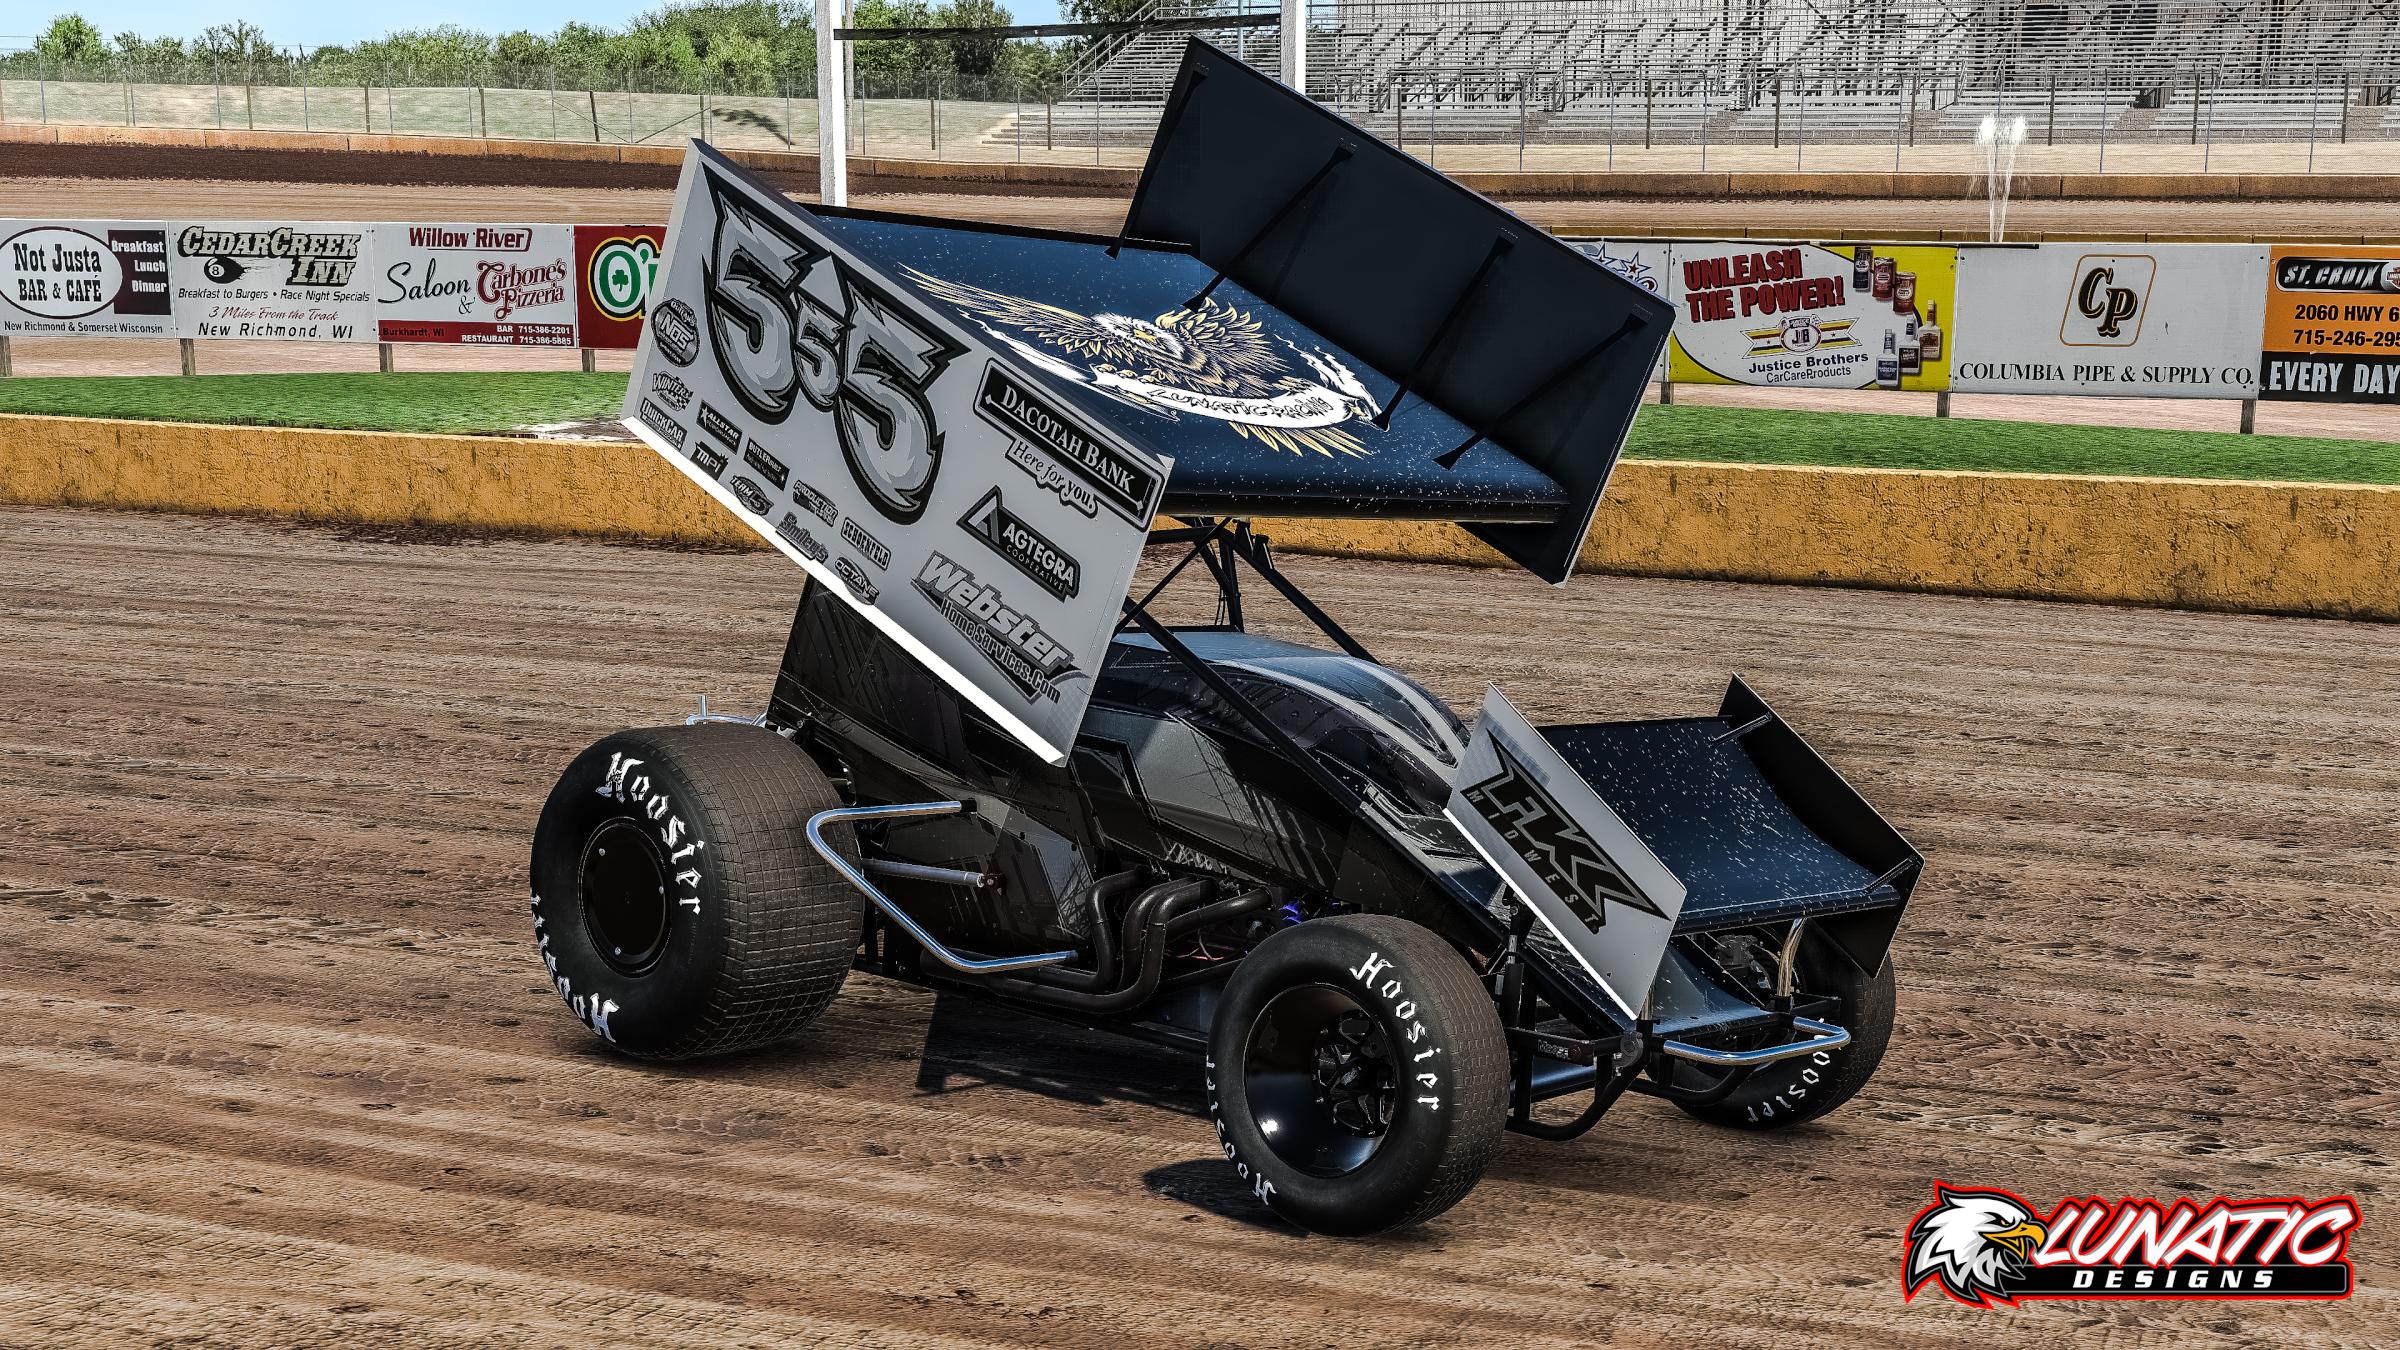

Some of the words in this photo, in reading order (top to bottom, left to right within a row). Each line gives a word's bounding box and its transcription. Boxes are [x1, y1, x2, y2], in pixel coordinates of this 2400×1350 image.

[111, 240, 165, 253] Breakfast
[409, 227, 469, 248] Willow
[475, 228, 525, 248] River
[13, 243, 47, 271] Not
[52, 244, 102, 272] Justa
[134, 260, 166, 272] Lunch
[1683, 248, 1803, 291] UNLEASH
[18, 279, 47, 301] BAR
[53, 282, 61, 299] &
[66, 275, 102, 302] CAFÉ
[131, 280, 167, 293] Dinner
[377, 258, 471, 304] Saloon
[477, 258, 567, 305] Carbone's
[2284, 264, 2311, 285] ST.
[2315, 264, 2380, 288] CROIX
[178, 288, 220, 299] Breakfast
[223, 289, 233, 299] to
[235, 289, 269, 301] Burgers
[280, 289, 302, 300] Race
[306, 290, 330, 302] Night
[332, 290, 370, 302] Specials
[458, 296, 475, 315] &
[494, 282, 565, 321] Pizzeria
[1685, 288, 1736, 323] THE
[1740, 275, 1846, 317] POWER!
[4, 321, 22, 331] New
[24, 321, 66, 332] Richmond
[68, 322, 75, 332] &
[78, 322, 117, 333] Somerset
[119, 323, 163, 333] Wisconsin
[209, 306, 220, 318] 3
[222, 306, 256, 319] Miles
[308, 309, 339, 321] Track
[2295, 304, 2339, 321] 2060
[2344, 305, 2384, 322] HWY
[198, 323, 231, 336] New
[239, 323, 322, 339] Richmond,
[332, 325, 353, 338] WI
[383, 327, 432, 338] Burkhardt,
[433, 328, 445, 337] WI
[462, 335, 514, 344] RESTAURANT
[519, 336, 572, 346] 715-386-5885
[497, 325, 514, 333] BAR
[518, 326, 570, 335] 715-386-2201
[660, 313, 695, 351] NOS
[1749, 359, 1801, 373] Justice
[1806, 353, 1869, 368] Brothers
[1960, 363, 2065, 381] COLUMBIA
[2073, 364, 2115, 383] PIPE
[2121, 365, 2136, 383] &
[2142, 366, 2217, 385] SUPPLY
[2221, 367, 2254, 385] CO.
[652, 373, 690, 399] WINTERS
[2269, 361, 2344, 392] EVERY
[2353, 364, 2400, 394] DAY
[707, 412, 740, 440] ALLSTAR
[1001, 384, 1081, 464] DACOTAH
[1083, 441, 1136, 494] BANK
[730, 477, 754, 497] TEAM
[1013, 441, 1044, 471] Here
[1042, 464, 1065, 487] for
[1063, 480, 1094, 510] you.
[794, 481, 838, 517] PRODUCTION
[843, 521, 890, 568] SCHOENFELD
[1003, 523, 1078, 588] AGTEGRA
[835, 558, 879, 597] OCTANE
[1006, 544, 1065, 591] COOPERATIVE
[918, 552, 1071, 671] Webster
[595, 751, 705, 915] Hoosier
[1465, 790, 1599, 924] MIDWEST
[1349, 951, 1441, 1111] Hoosier
